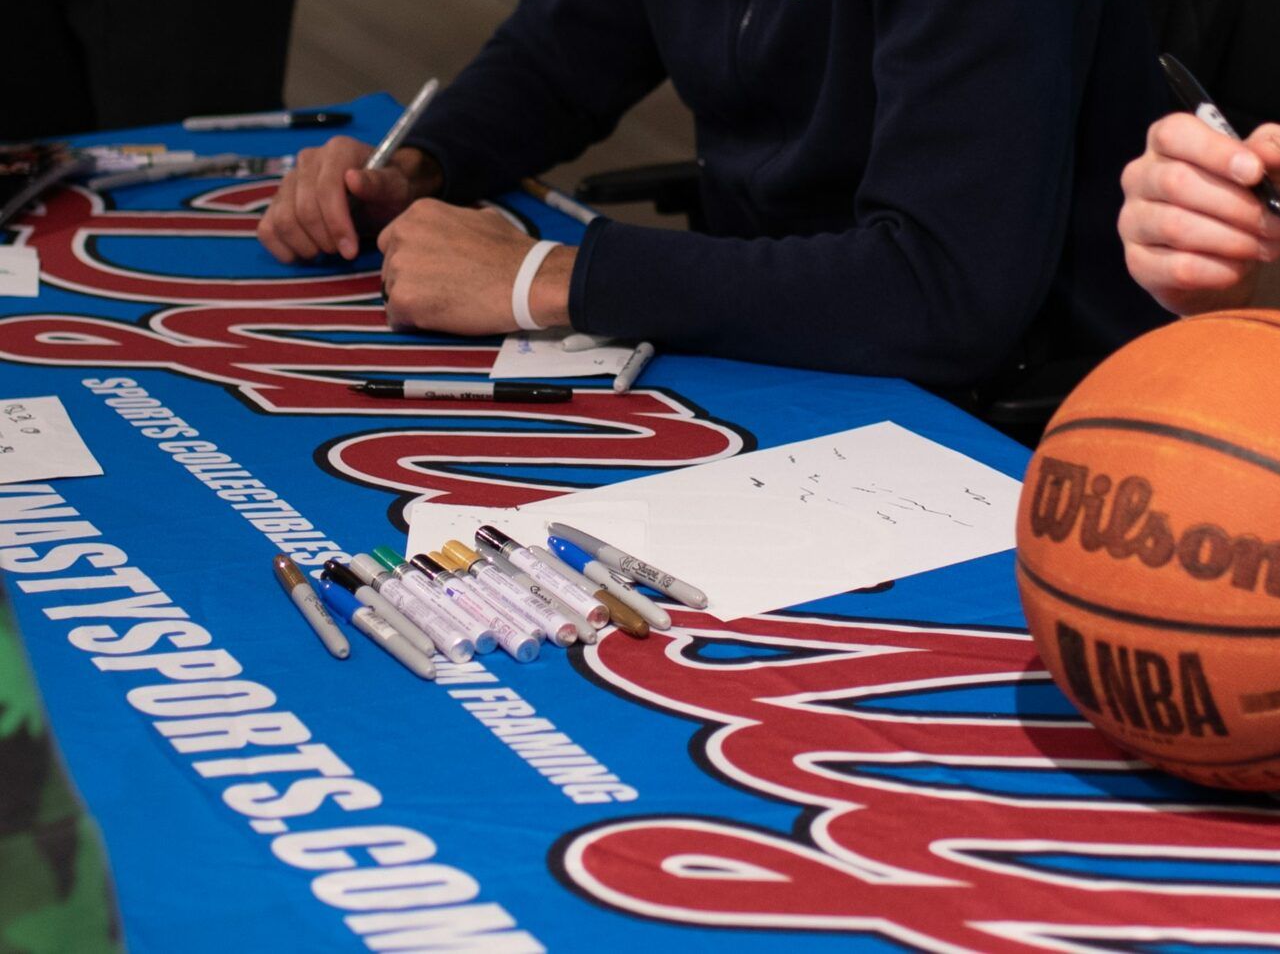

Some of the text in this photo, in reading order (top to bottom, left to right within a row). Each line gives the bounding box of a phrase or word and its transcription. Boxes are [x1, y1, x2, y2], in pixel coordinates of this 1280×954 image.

[0, 484, 548, 954] NASTYSPORTS.COM
[81, 377, 639, 804] SPORTS COLLECTIBLES FRAMING
[1095, 640, 1229, 737] NBA
